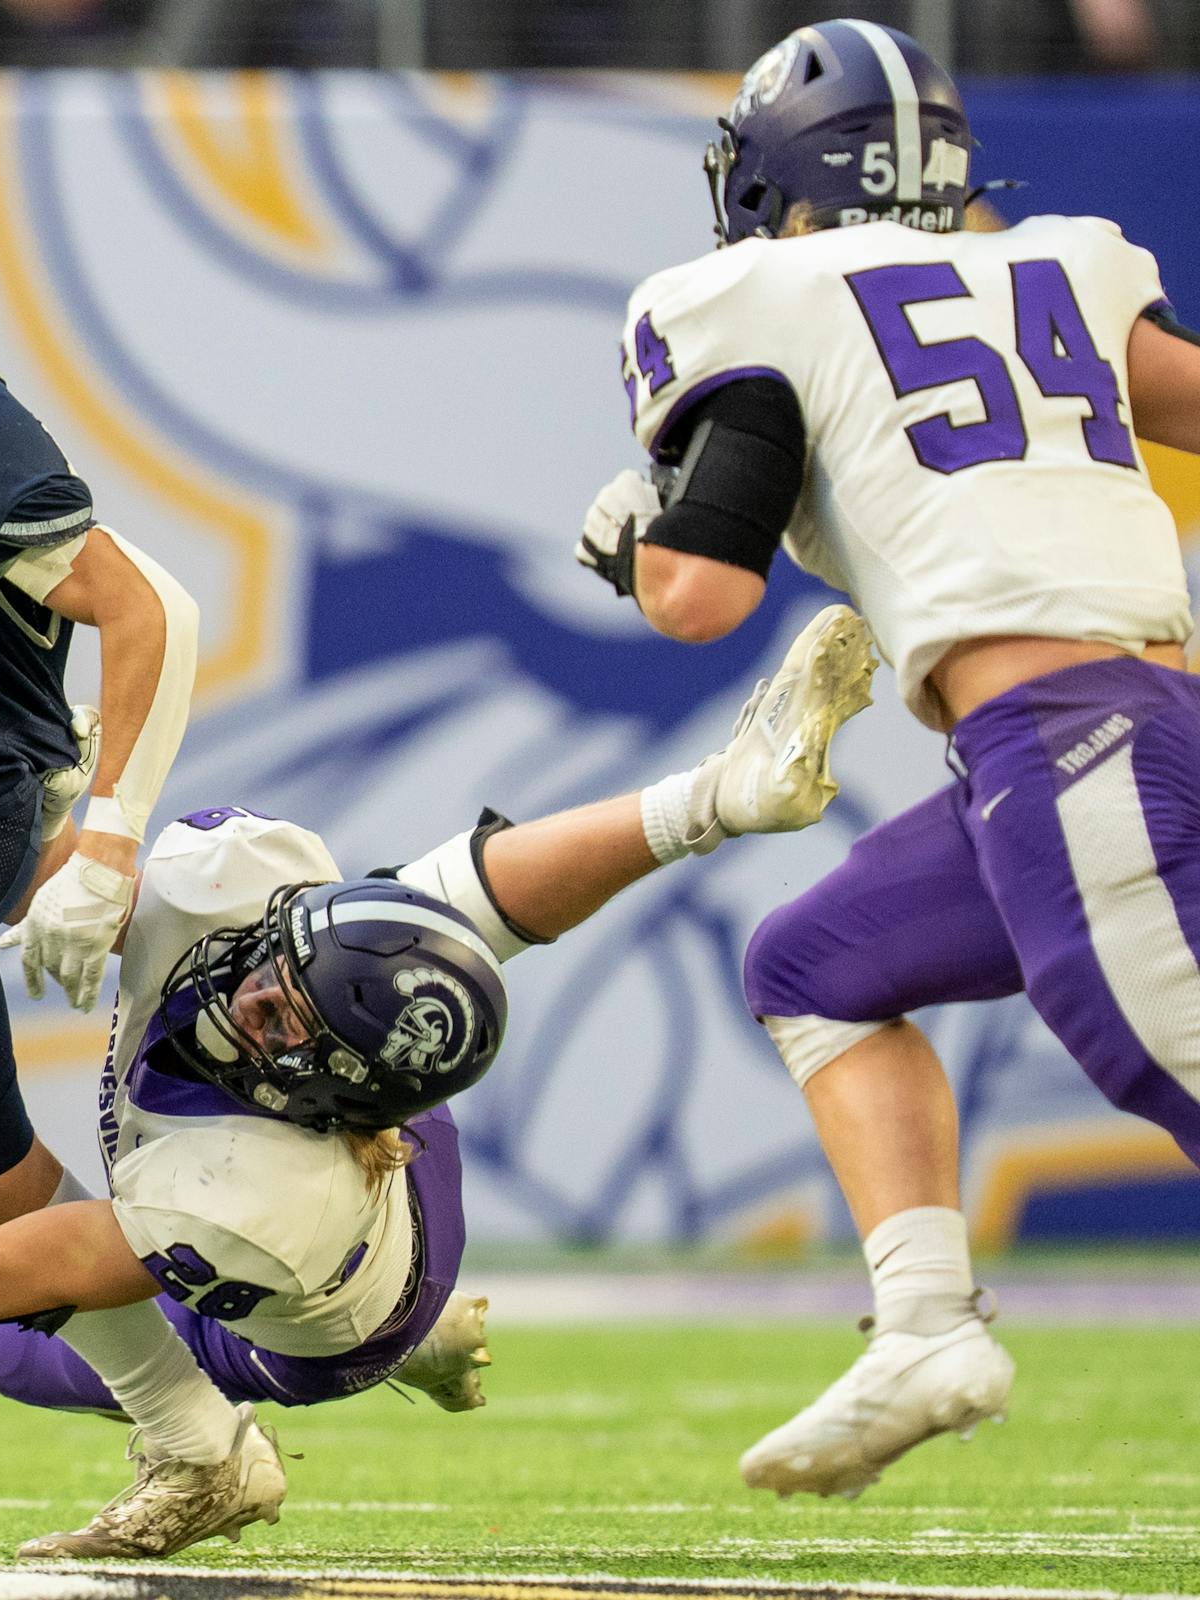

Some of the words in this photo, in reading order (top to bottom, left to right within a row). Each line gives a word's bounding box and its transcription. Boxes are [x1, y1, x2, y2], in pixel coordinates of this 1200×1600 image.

[842, 259, 1140, 475] 54
[1057, 713, 1134, 775] TROJANS
[291, 905, 311, 958] Riddell
[140, 1242, 278, 1321] 28
